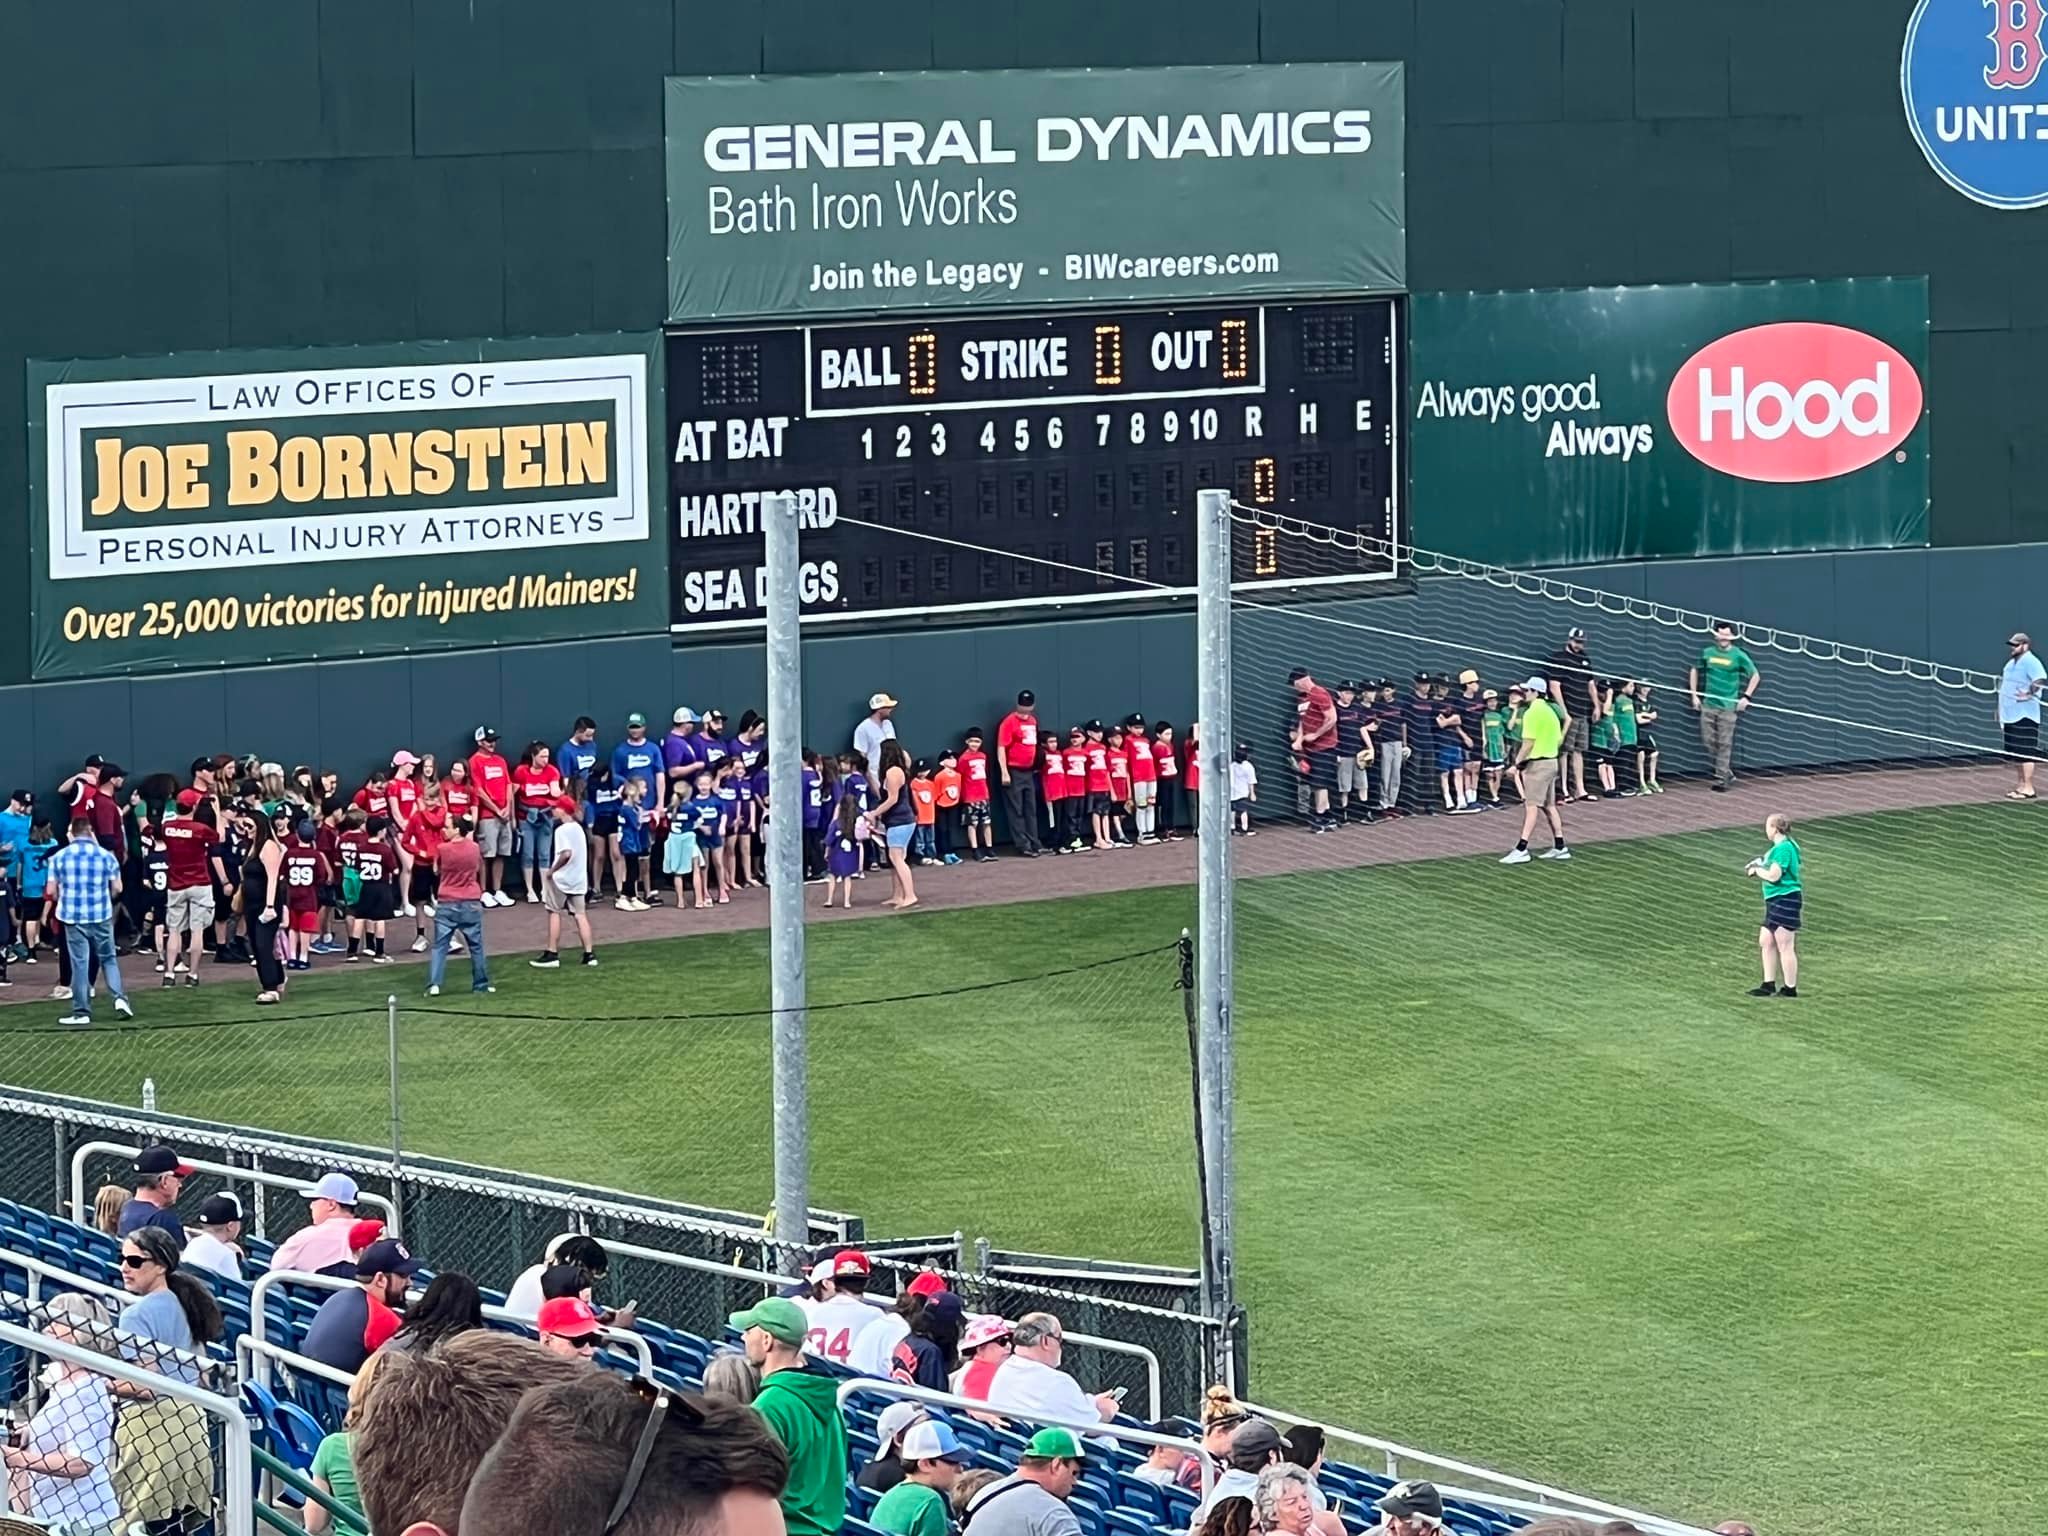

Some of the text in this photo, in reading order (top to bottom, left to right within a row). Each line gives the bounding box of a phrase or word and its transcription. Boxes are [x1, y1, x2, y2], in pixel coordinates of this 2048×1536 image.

[1983, 0, 2048, 89] B
[704, 109, 1372, 173] GENERAL DYNAMICS
[709, 177, 1019, 234] Bath Iron Works
[809, 261, 865, 292] Join
[872, 260, 917, 288] the
[927, 257, 1023, 289] Legacy
[1065, 251, 1279, 281] BIWcareers.com
[820, 320, 1246, 395] BALL 0 STRIKE 0 OUT 0
[207, 373, 496, 411] LAW OFFICES OF
[1416, 374, 1601, 424] Always good.
[1699, 361, 1890, 442] Hood
[675, 416, 789, 463] AT BAT
[861, 400, 1372, 459] 1 2 3 4 5 6 7 8 9 10 R H E
[1545, 420, 1653, 462] Always
[91, 420, 608, 516] JOE BORNSTEIN
[1254, 458, 1275, 502] 0
[100, 510, 605, 564] PERSONAL INJURY ATTORNEYS
[63, 567, 637, 642] Over 25,000 victories for injured Mainers!
[684, 560, 839, 613] SEA DGS
[359, 861, 383, 881] 20
